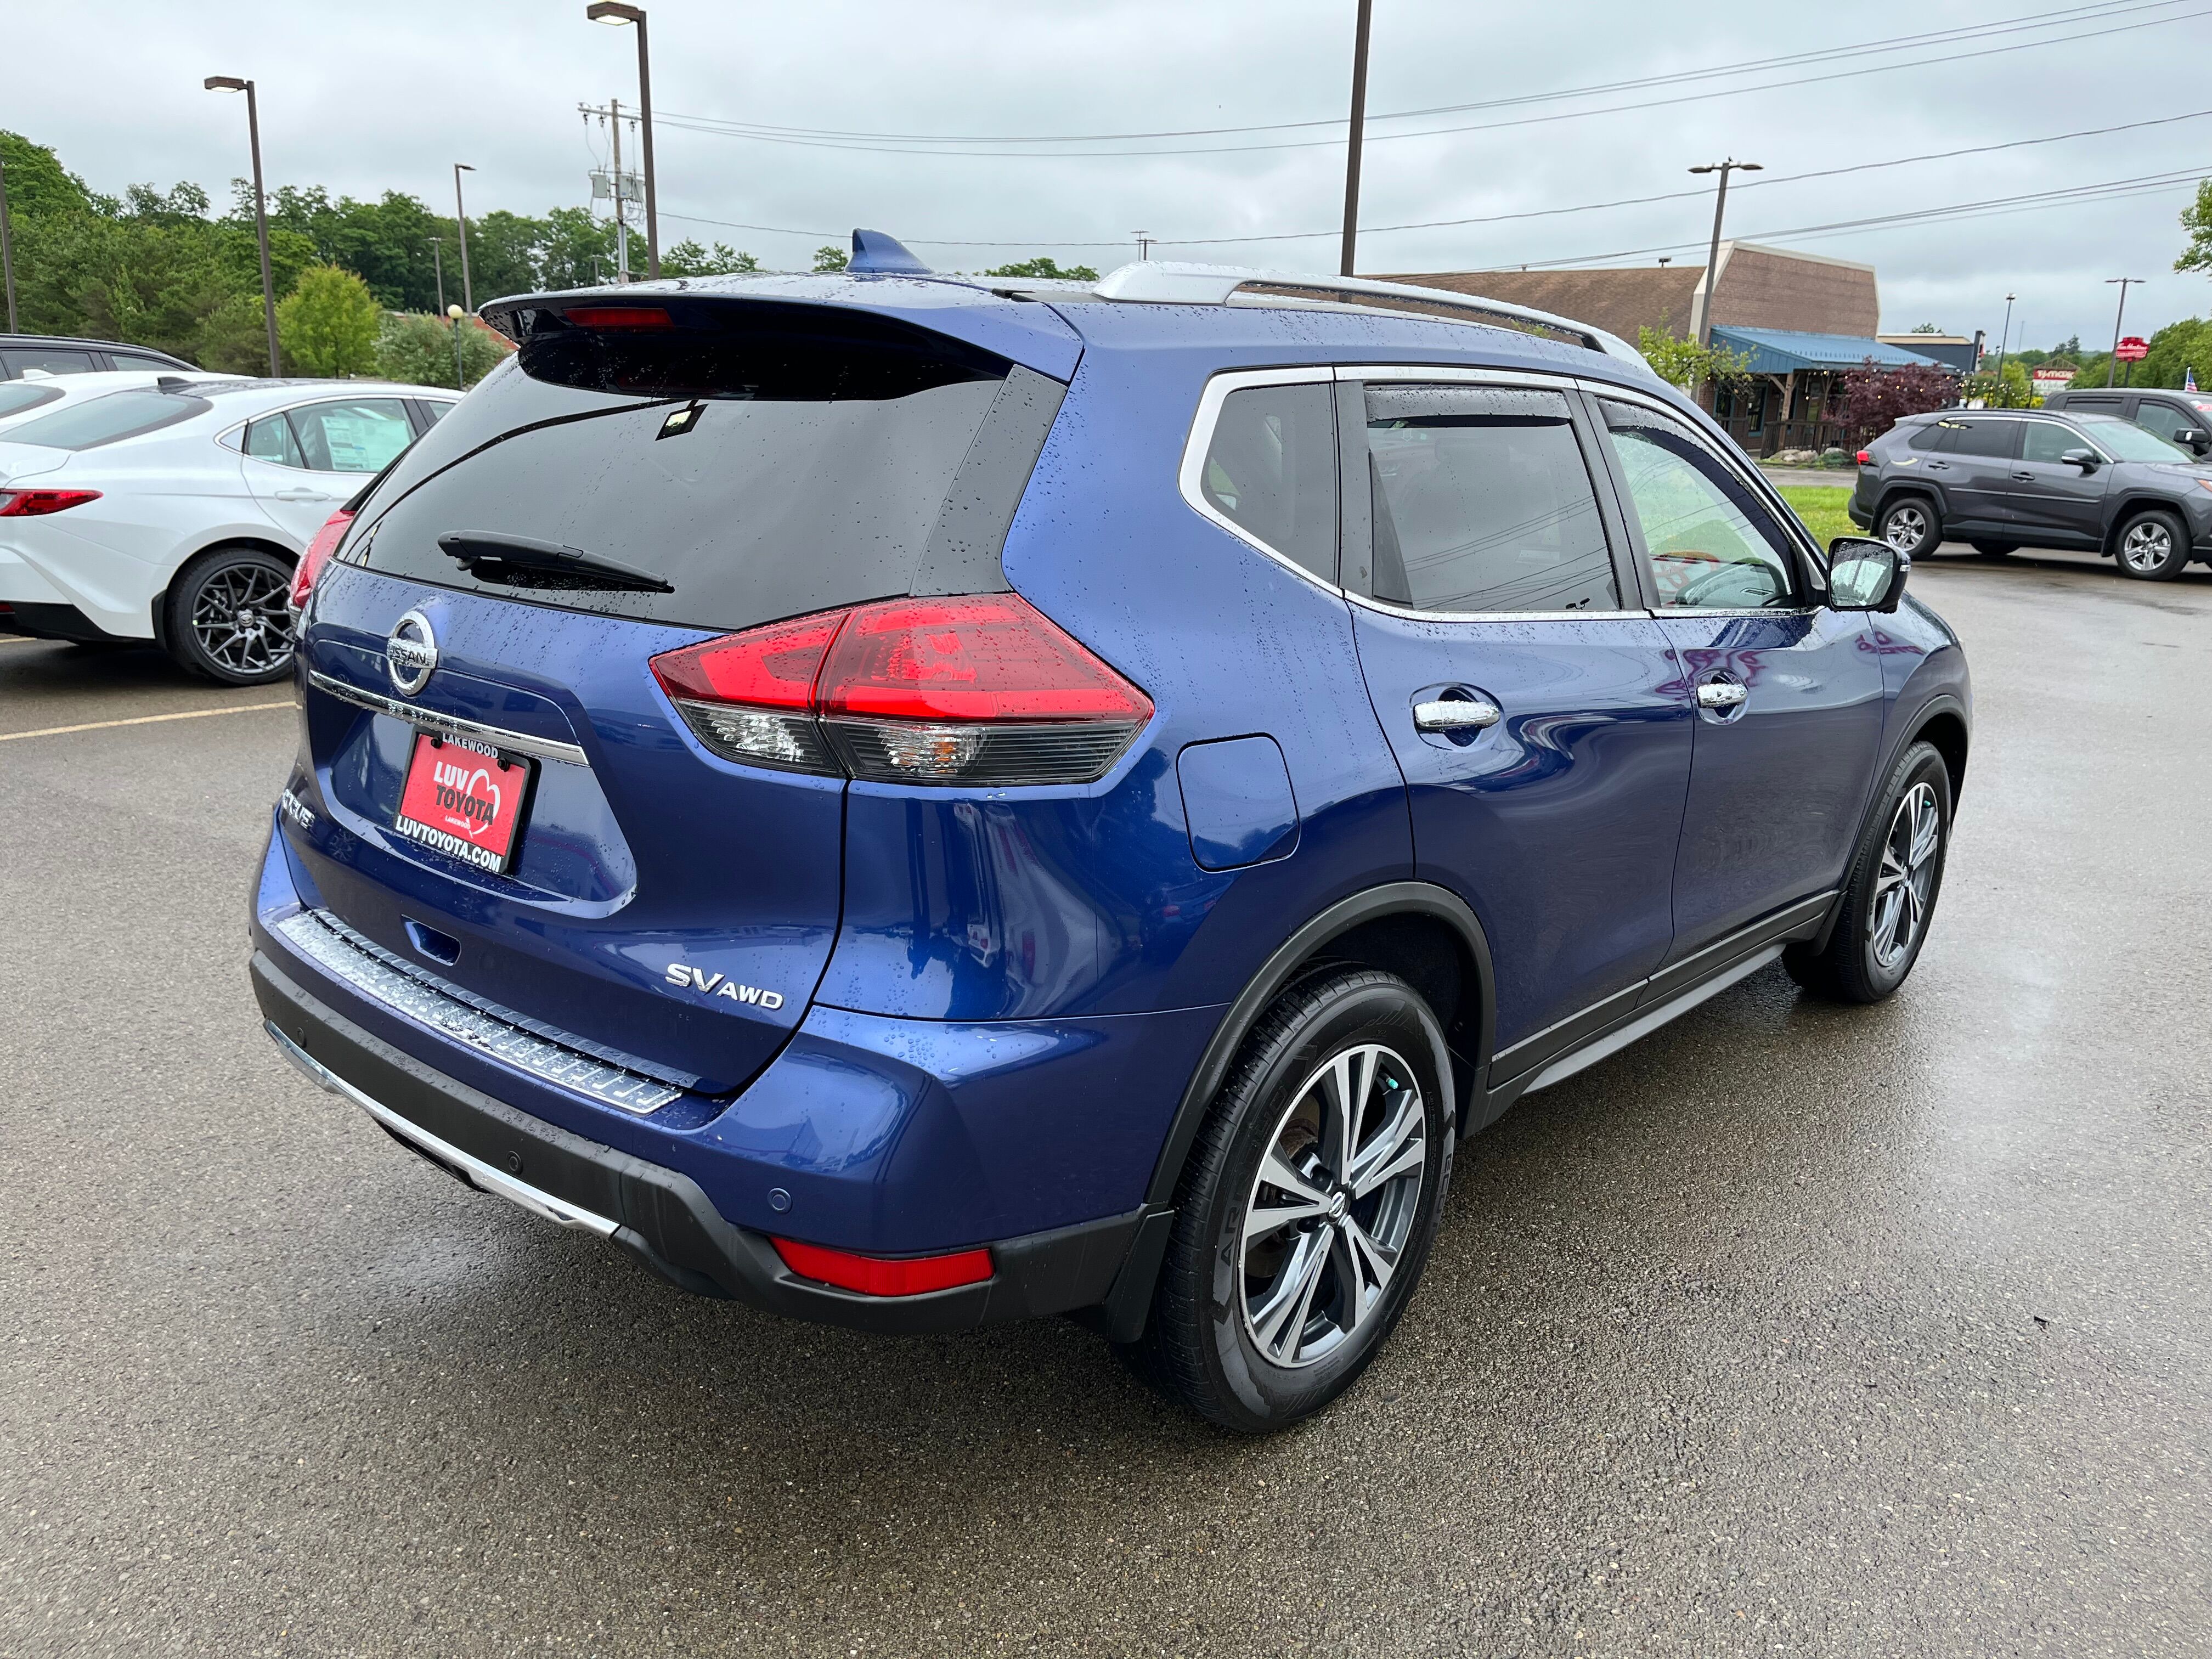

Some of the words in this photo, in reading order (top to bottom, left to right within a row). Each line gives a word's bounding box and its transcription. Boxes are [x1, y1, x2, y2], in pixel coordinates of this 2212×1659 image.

[442, 732, 499, 759] LAKEWOOD
[433, 761, 470, 791] LUV
[436, 785, 495, 826] TOYOTA
[444, 815, 471, 830] LAKEWOOD
[395, 815, 502, 872] LUVTOYOTA.COM
[665, 963, 725, 994] SV
[716, 981, 785, 1010] AWD
